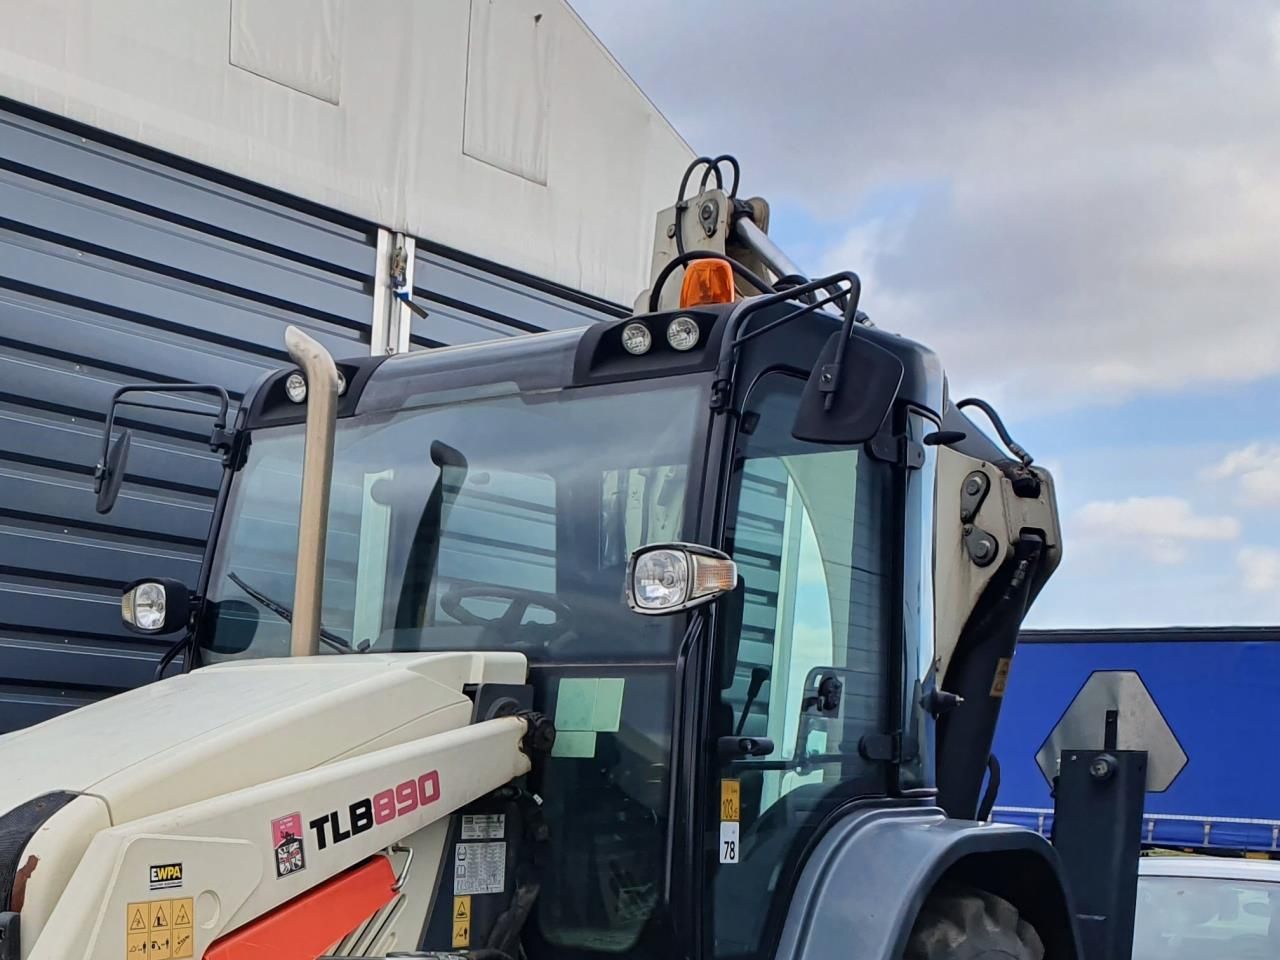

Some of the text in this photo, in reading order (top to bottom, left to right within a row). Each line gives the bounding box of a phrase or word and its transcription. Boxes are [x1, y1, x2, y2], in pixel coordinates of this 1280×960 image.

[309, 769, 441, 851] TLB890
[723, 840, 736, 860] 78
[150, 865, 182, 881] EWPA
